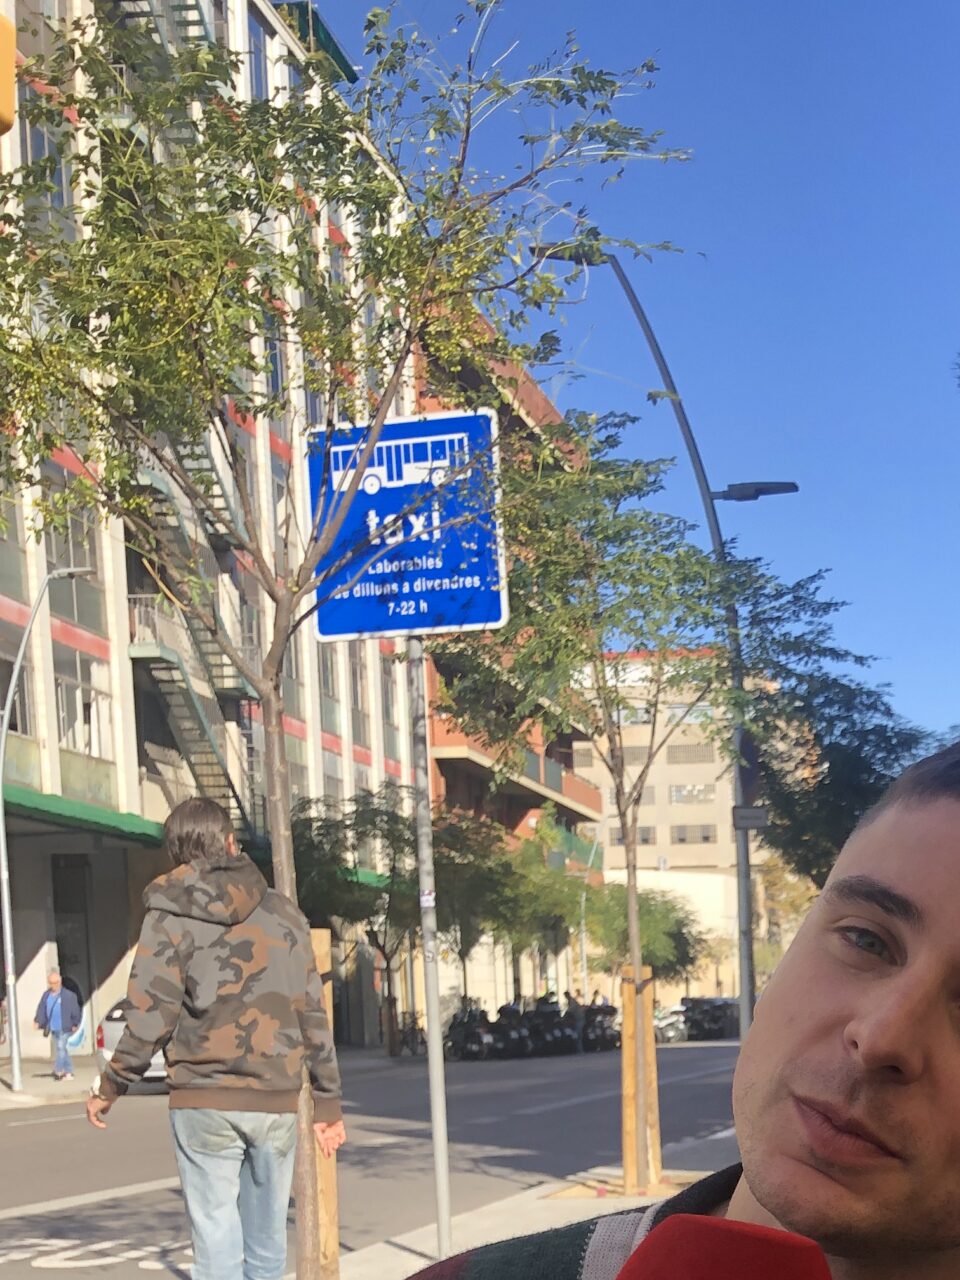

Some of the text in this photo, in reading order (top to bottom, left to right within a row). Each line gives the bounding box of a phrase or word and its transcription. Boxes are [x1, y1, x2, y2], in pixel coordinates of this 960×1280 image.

[366, 502, 442, 545] taxi
[368, 556, 443, 575] Laborables
[353, 581, 399, 598] dilluns
[402, 581, 410, 594] a
[413, 575, 482, 593] divendres
[388, 599, 428, 616] 7-22 h
